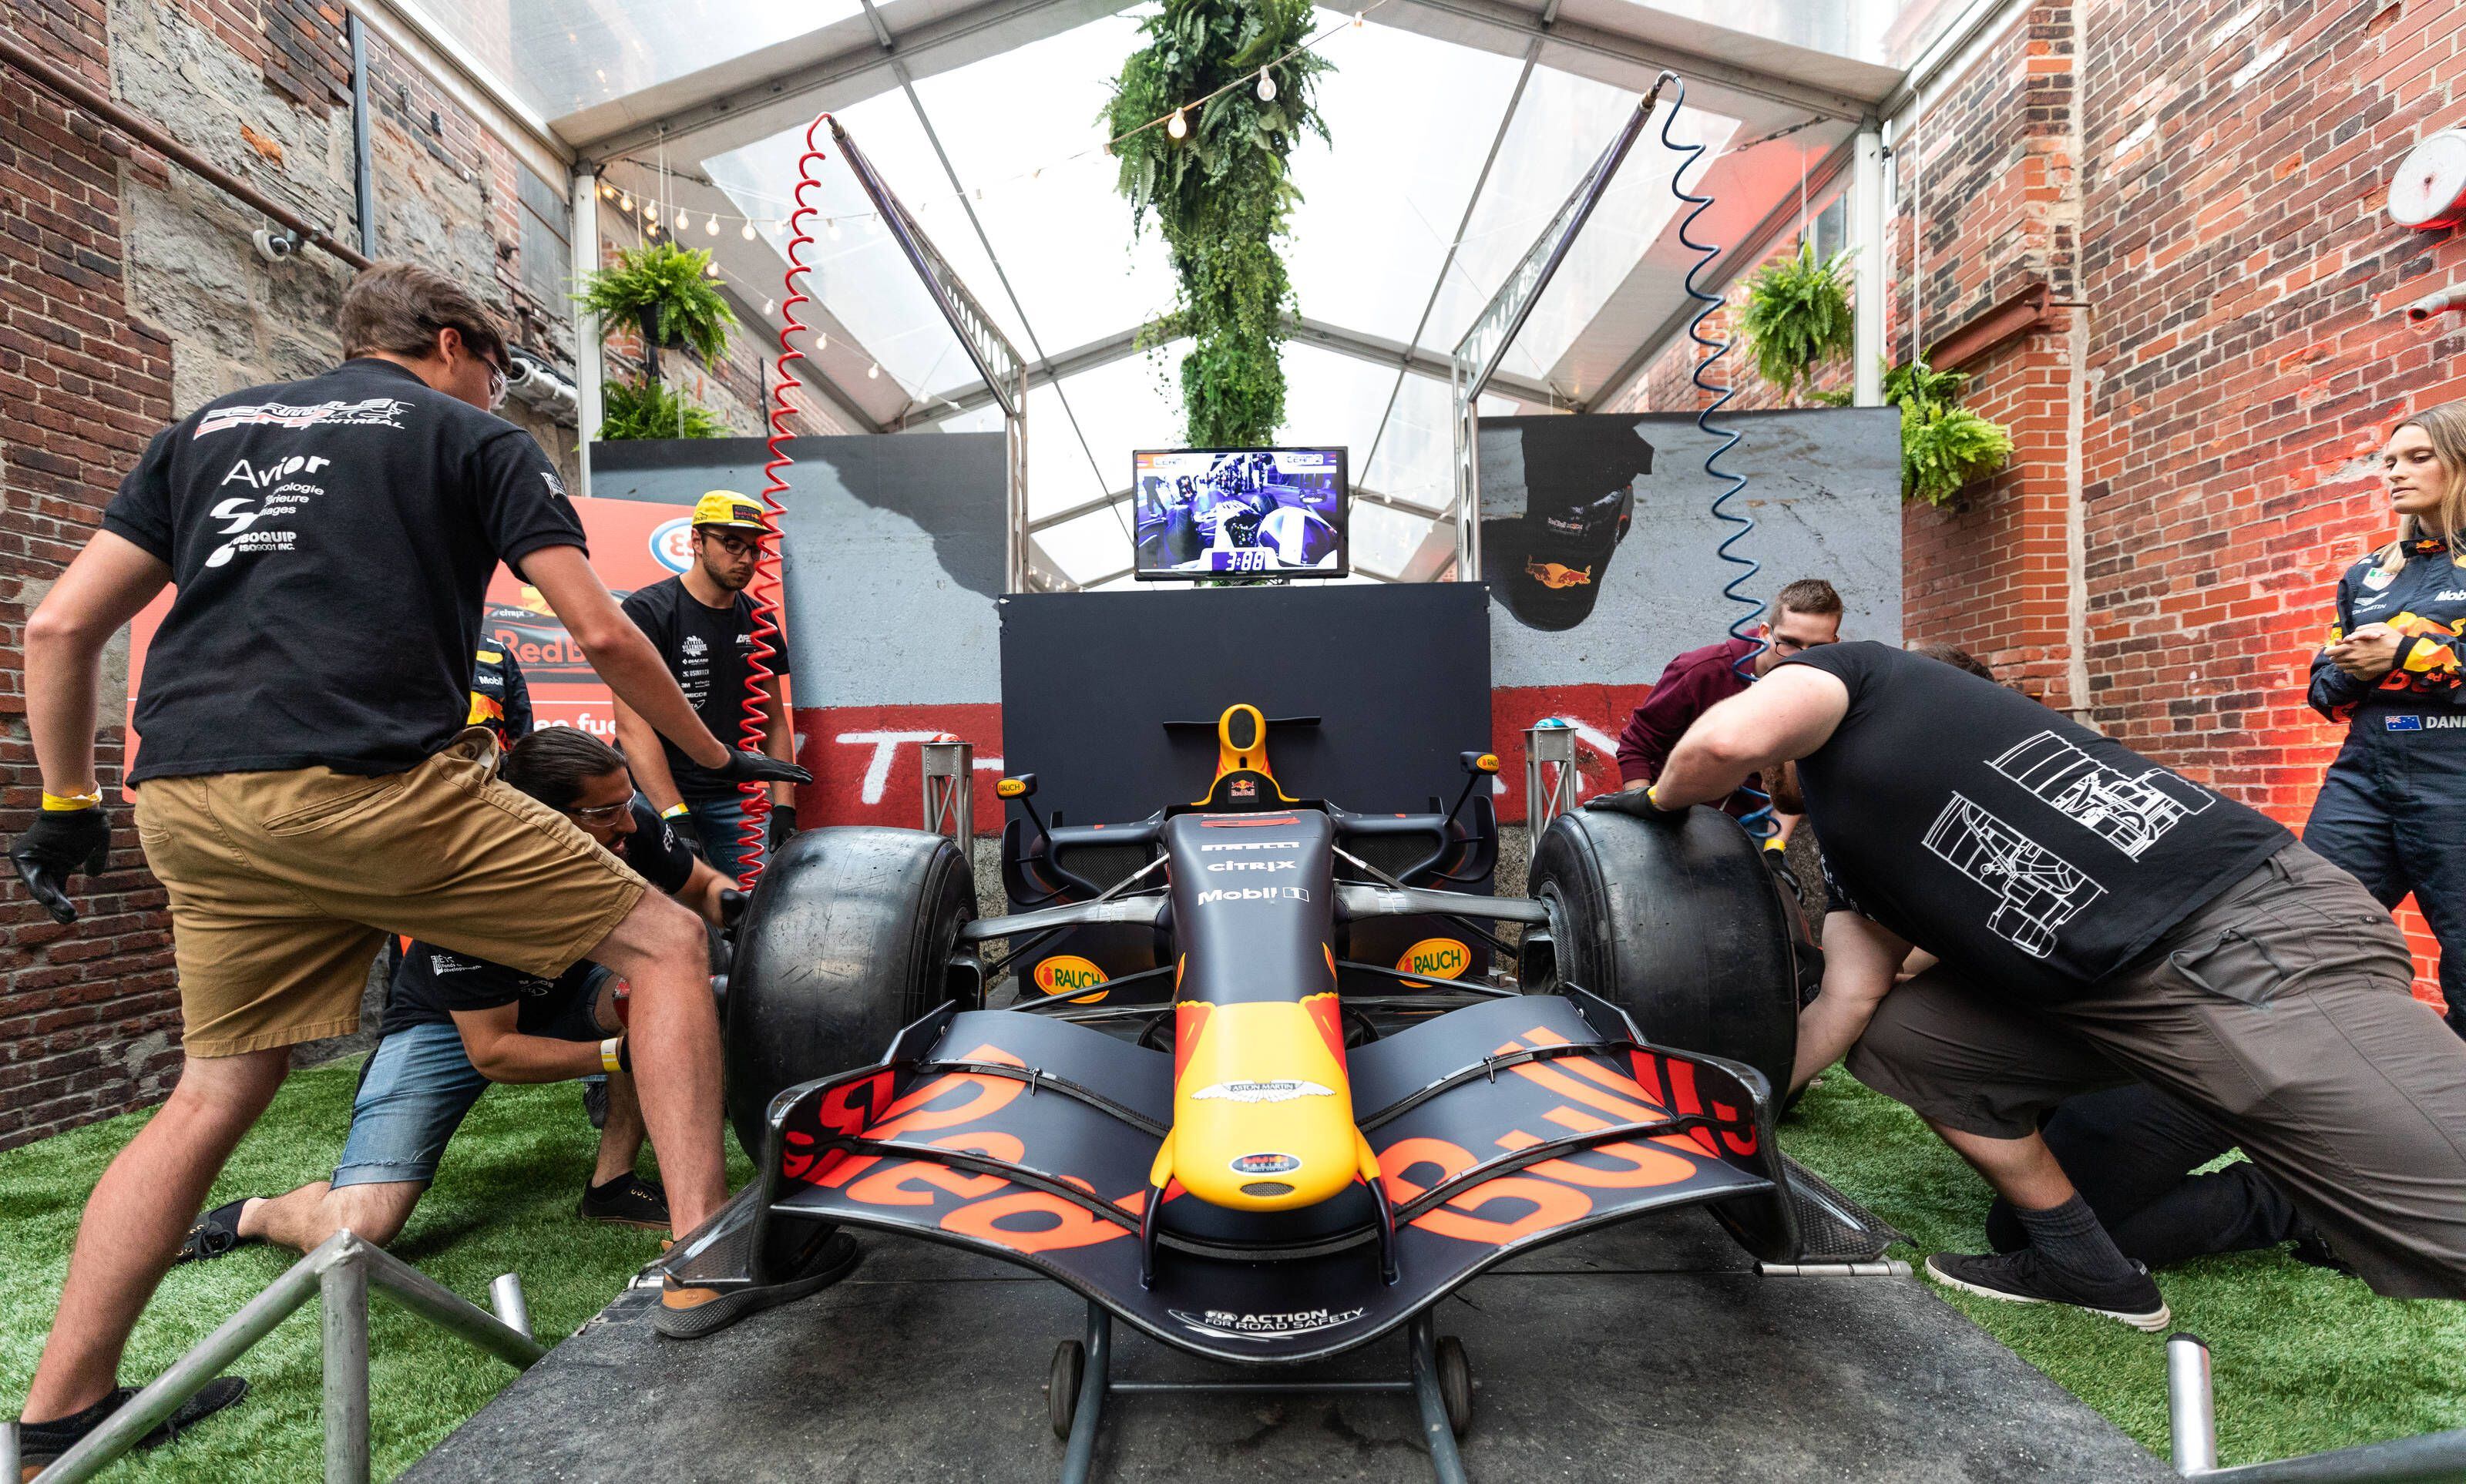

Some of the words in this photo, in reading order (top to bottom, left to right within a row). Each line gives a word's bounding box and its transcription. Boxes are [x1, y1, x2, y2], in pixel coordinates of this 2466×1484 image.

[221, 456, 331, 489] Avior
[2434, 589, 2466, 601] Mob
[1198, 887, 1278, 906] Mobil
[1414, 948, 1461, 974] RAUCH
[1054, 968, 1100, 989] RAUCH
[1205, 1318, 1231, 1327] FOR
[1236, 1321, 1288, 1331] ROAD
[1294, 1308, 1363, 1328] SAFETY
[1241, 1309, 1328, 1324] ACTION
